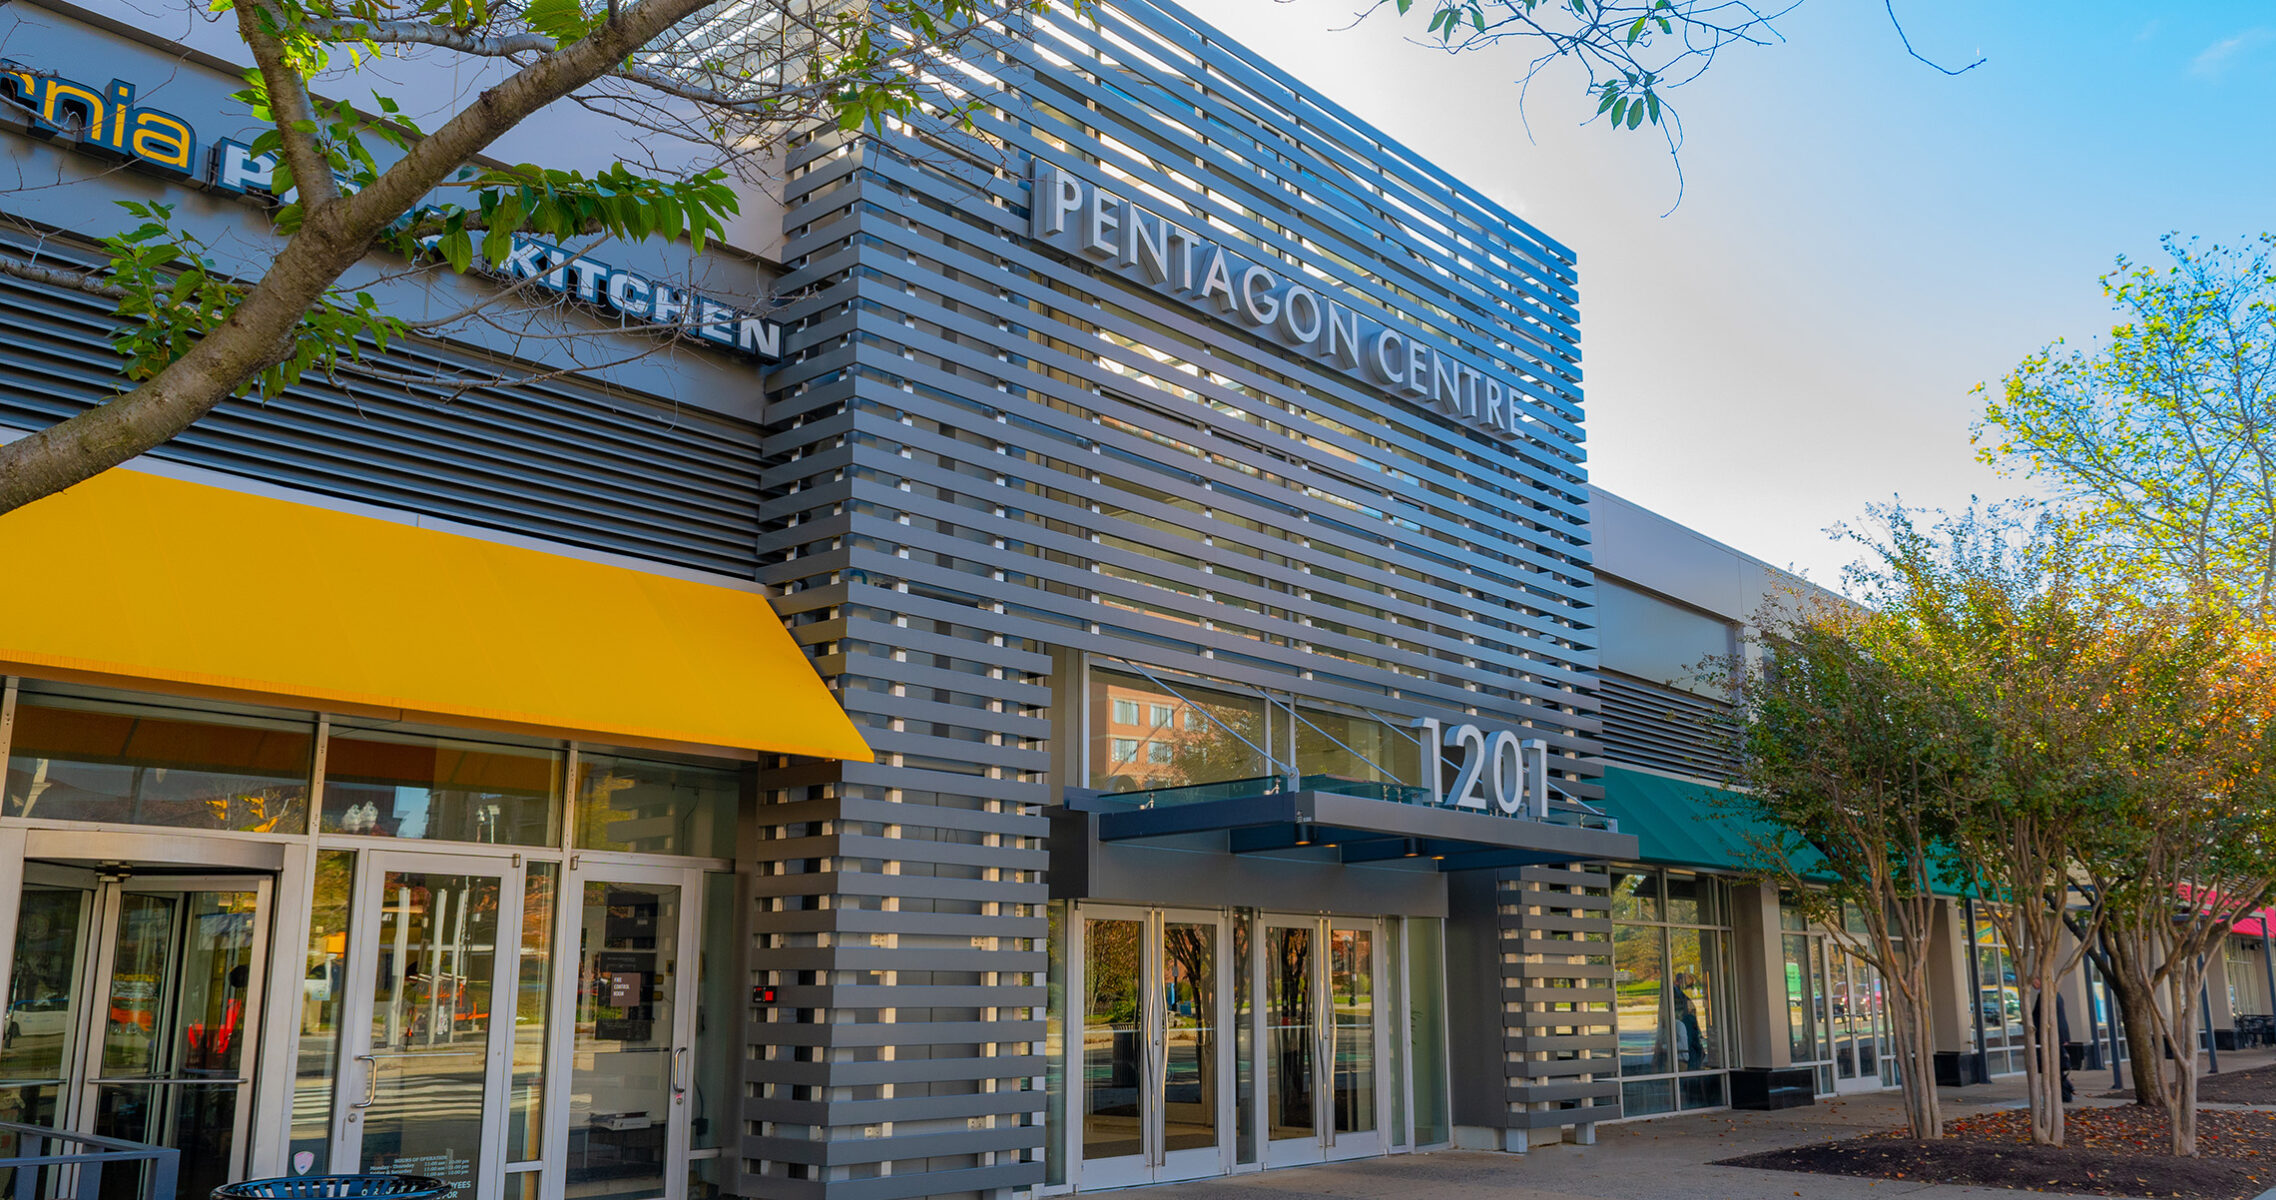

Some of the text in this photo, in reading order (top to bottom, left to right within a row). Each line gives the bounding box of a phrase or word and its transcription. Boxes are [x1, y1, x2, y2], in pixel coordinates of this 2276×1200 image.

[499, 236, 781, 358] KITCHEN
[1046, 169, 1525, 440] PENTAGON CENTRE
[1411, 716, 1549, 818] 1201
